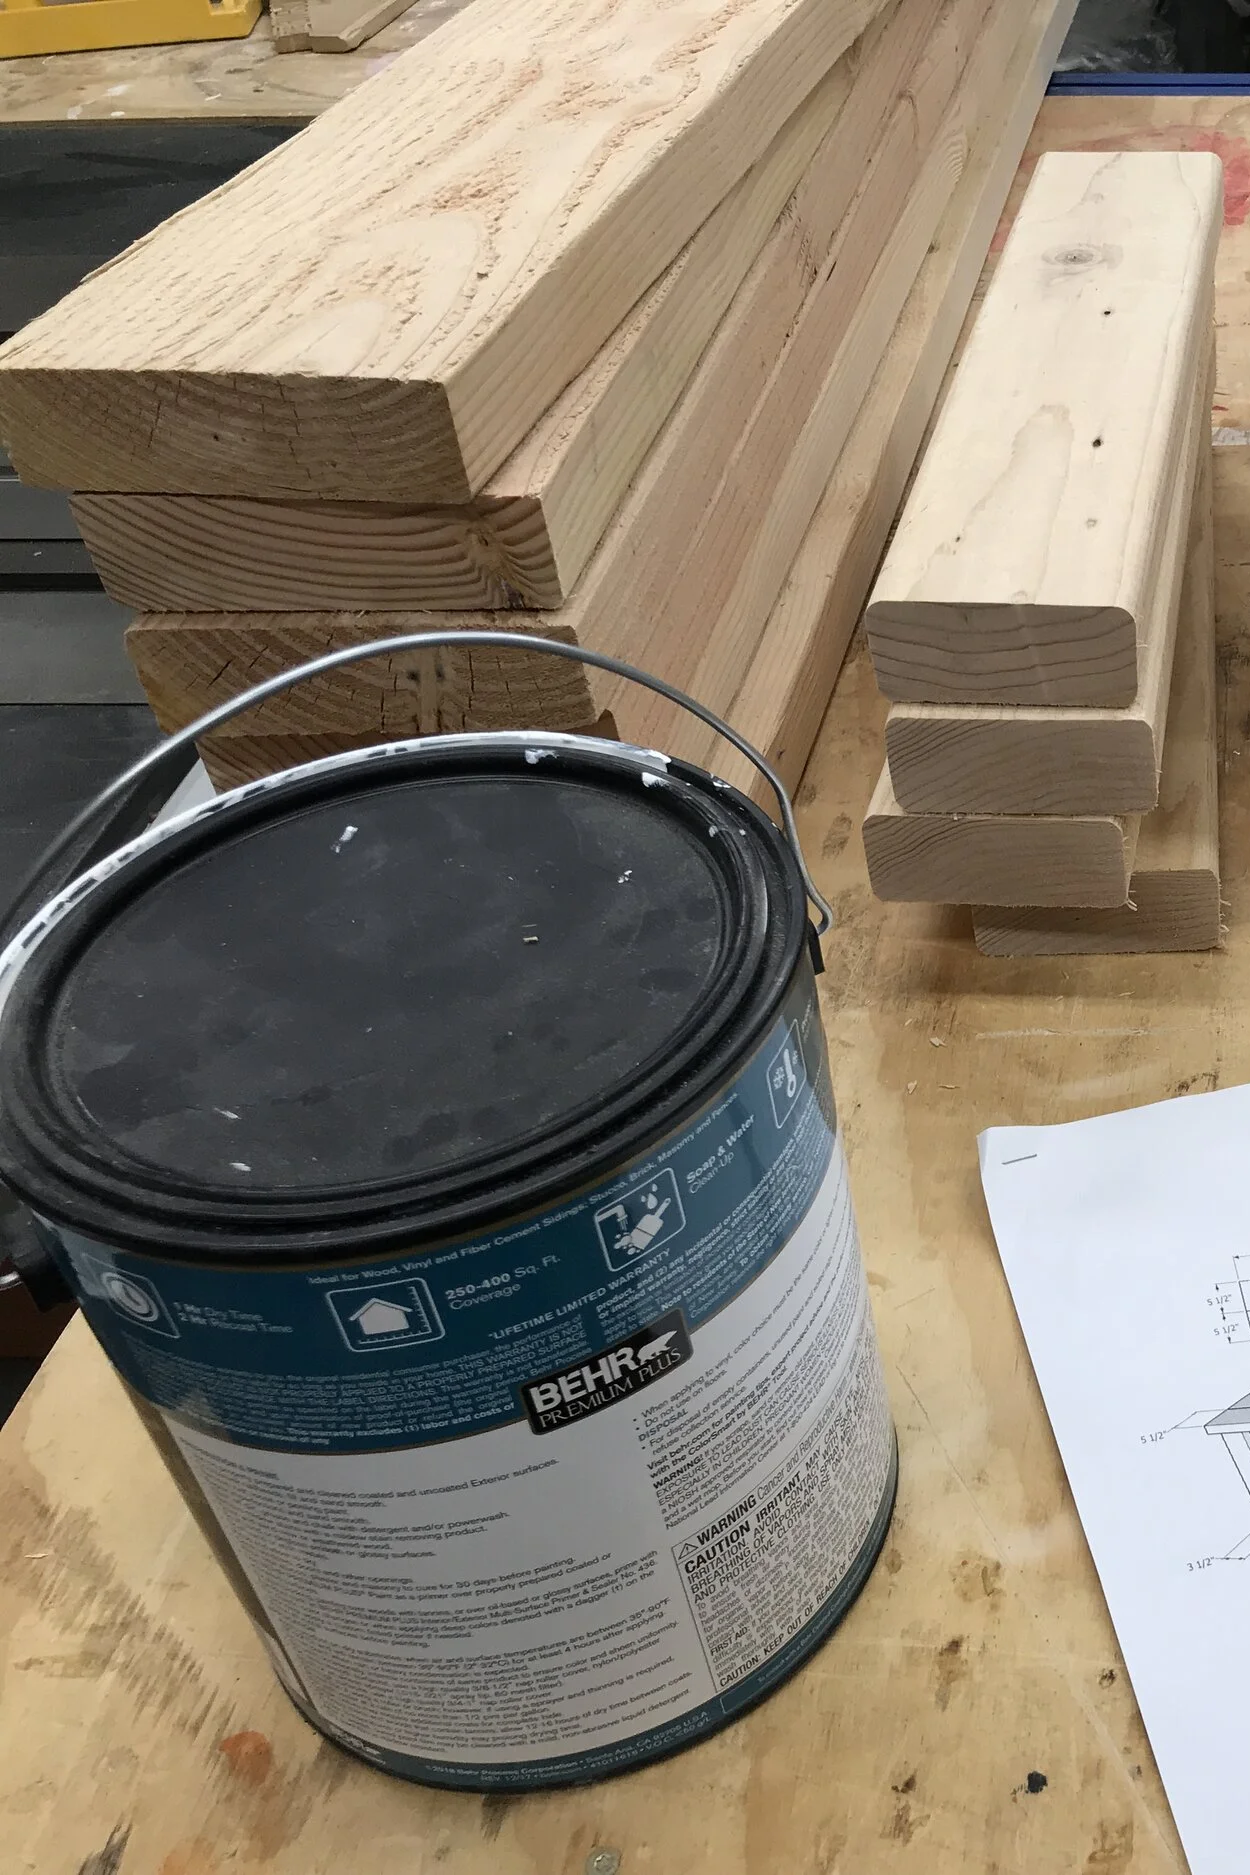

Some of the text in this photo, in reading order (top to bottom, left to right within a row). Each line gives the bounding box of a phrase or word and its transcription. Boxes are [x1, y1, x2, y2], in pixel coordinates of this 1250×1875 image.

[686, 1115, 755, 1183] Soap & Water
[689, 1152, 734, 1194] Clean-Up
[309, 1274, 340, 1284] Ideal
[403, 1258, 432, 1272] Vinyl
[435, 1251, 458, 1264] and
[460, 1241, 491, 1256] Fiber
[494, 1223, 540, 1245] Cement
[657, 1133, 695, 1163] Masonry
[445, 1254, 560, 1300] 250-400 Sq. Ft.
[449, 1283, 521, 1310] Coverage
[556, 1287, 606, 1316] LIMITED
[608, 1248, 670, 1290] WARRANTY
[1207, 1298, 1213, 1306] 5
[538, 1331, 587, 1355] SURFACE
[1214, 1328, 1220, 1336] 5
[529, 1347, 639, 1413] BEHR
[539, 1348, 681, 1427] PREMIUM PLUS
[639, 1409, 688, 1441] DISPOSAL
[642, 1400, 668, 1418] When
[647, 1428, 711, 1470] Visit behr.com
[650, 1418, 735, 1478] with ColorSmart
[1140, 1435, 1147, 1444] 5
[419, 1482, 468, 1497] uncoated
[470, 1472, 510, 1488] Exterior
[653, 1454, 704, 1489] WARNING!
[656, 1461, 708, 1498] EXPOSURE
[659, 1468, 710, 1506] ESPECIALLY
[697, 1401, 835, 1546] WARNING Cancer and Reproductive
[684, 1446, 821, 1574] CAUTION IRRITANT MAY
[754, 1508, 780, 1538] AVOID
[785, 1463, 819, 1506] CONTACT
[691, 1498, 801, 1594] BREATHING VAPORS
[694, 1494, 815, 1603] AND PROTECTIVE CLOTHING
[1187, 1563, 1193, 1571] 3
[720, 1575, 838, 1687] CAUTION: KEEP OUT REACH
